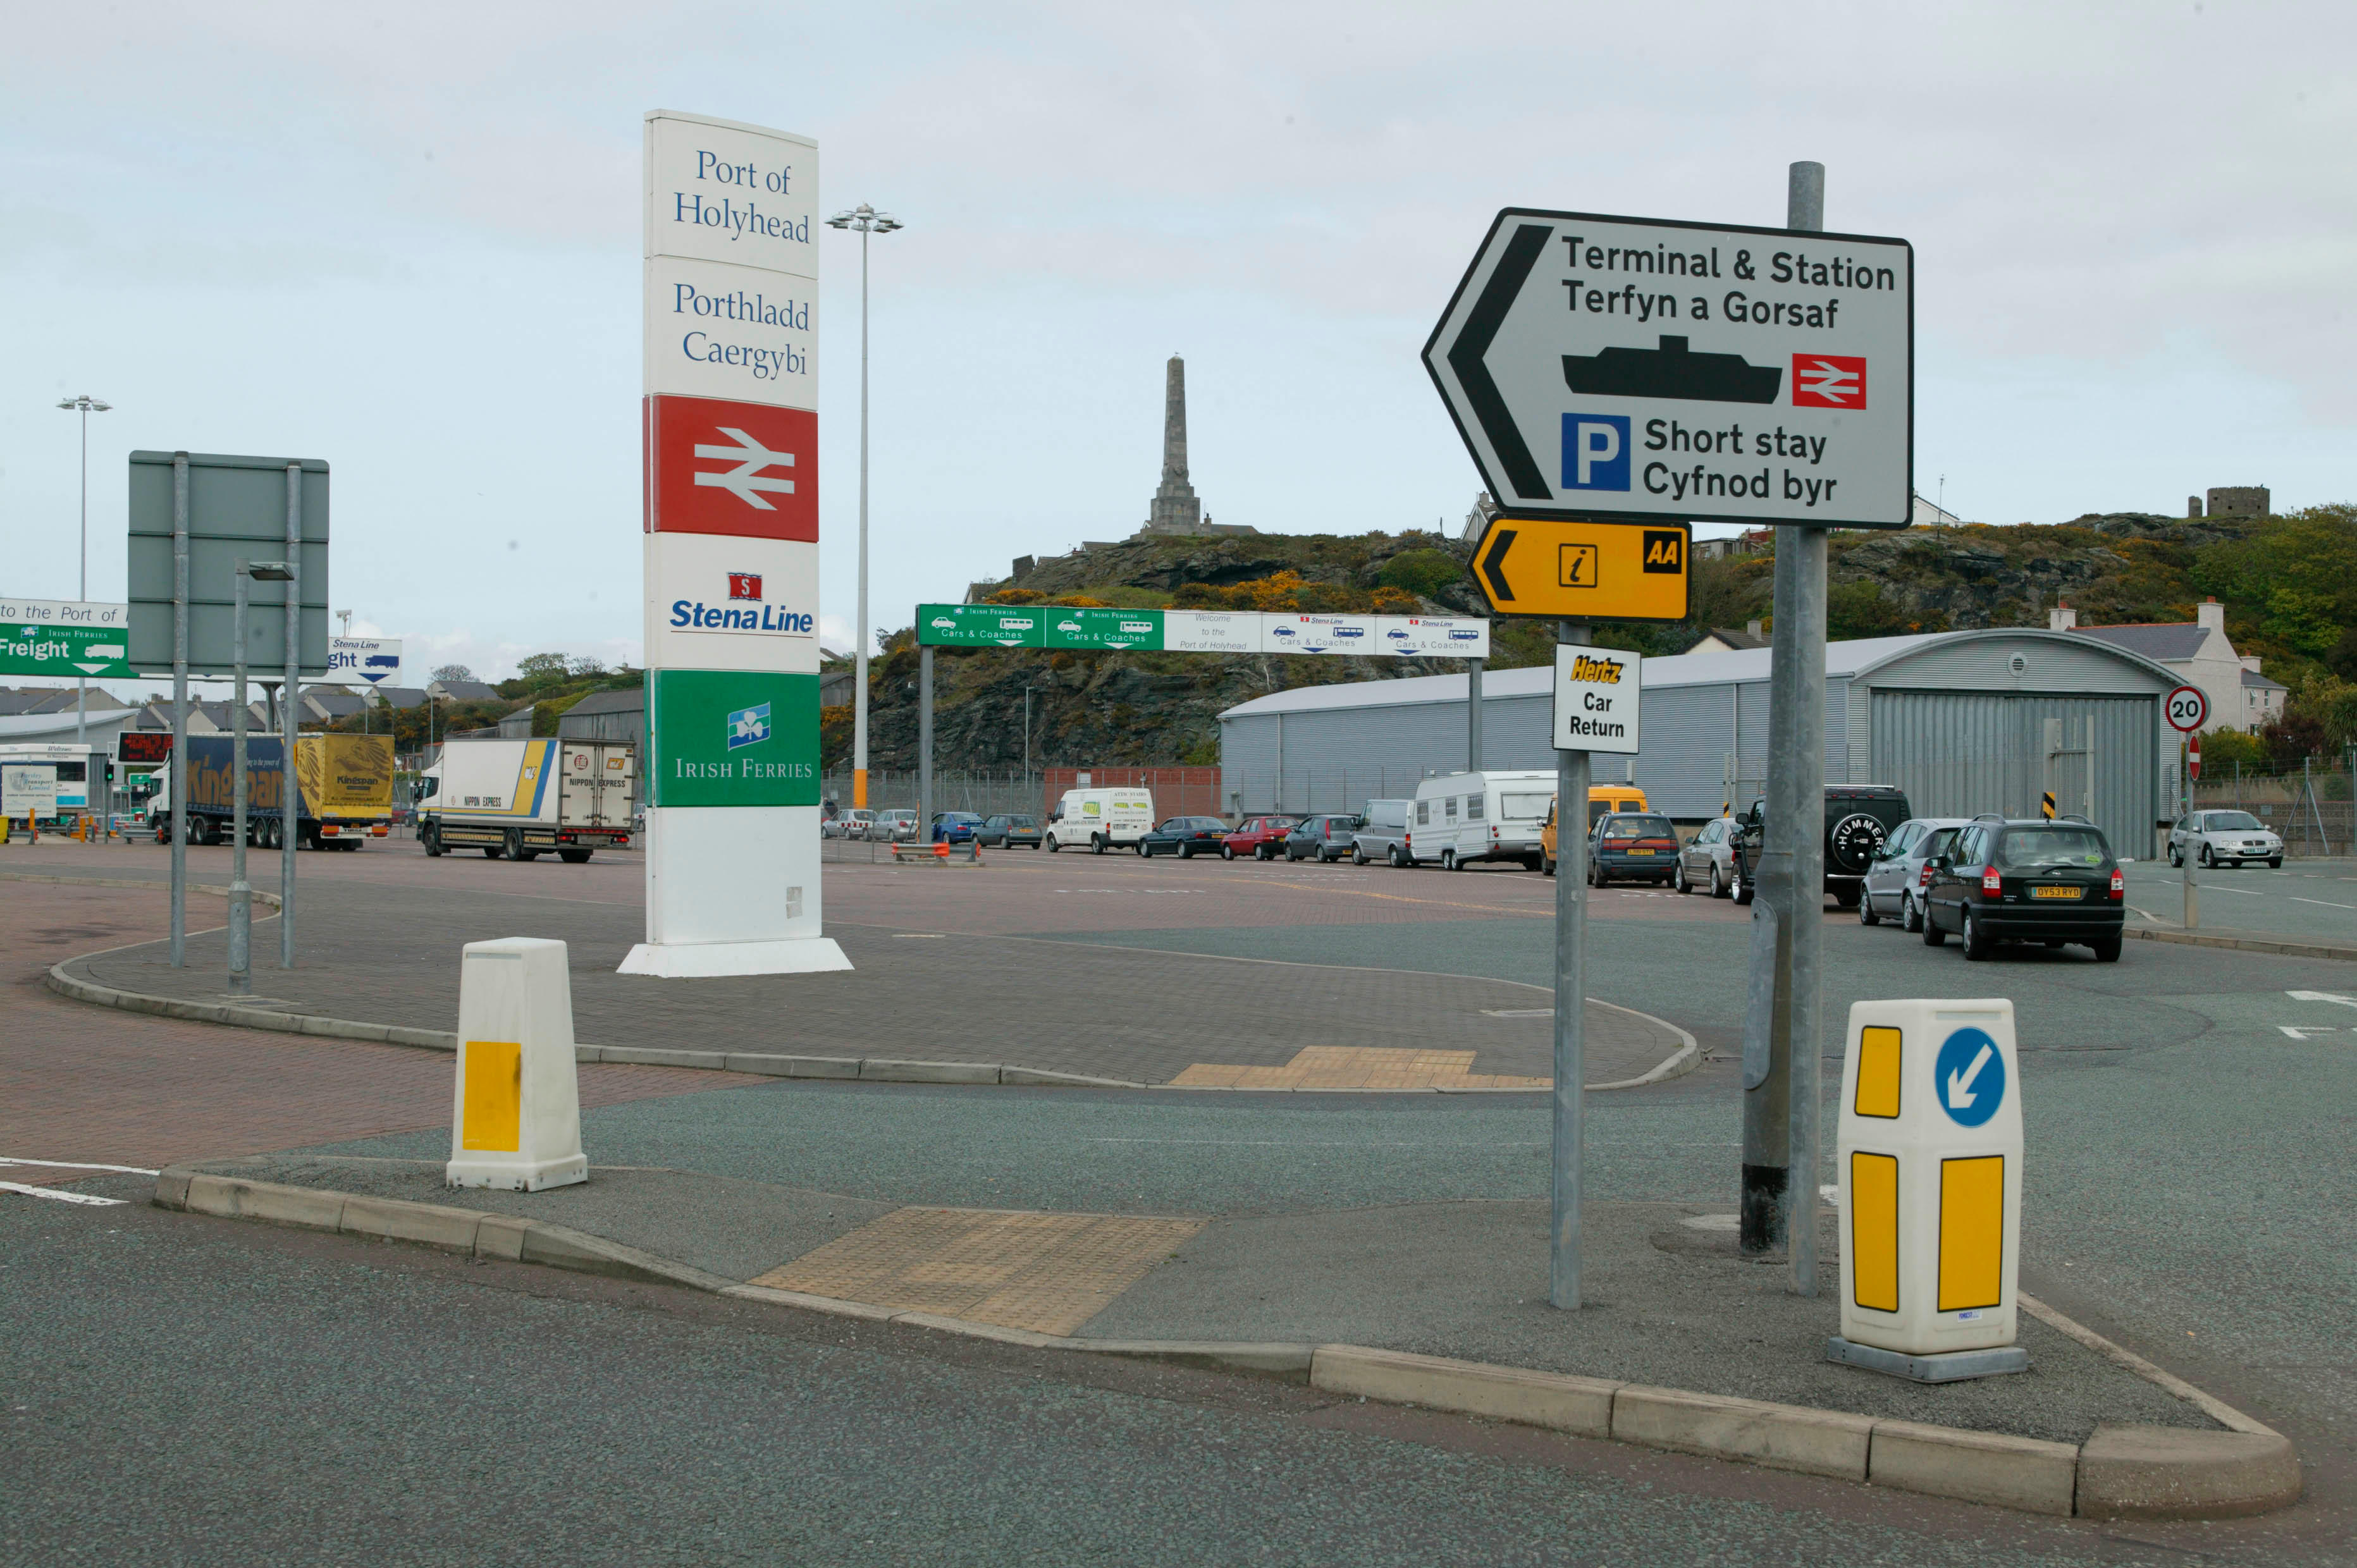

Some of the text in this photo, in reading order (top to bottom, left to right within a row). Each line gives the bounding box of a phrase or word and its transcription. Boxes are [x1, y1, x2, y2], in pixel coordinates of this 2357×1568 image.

[696, 150, 791, 195] Port of
[674, 192, 810, 244] Holyhead
[1561, 236, 1895, 291] Terminal & Station
[674, 283, 809, 331] Porthladd
[1561, 279, 1839, 329] Terfyn a Gorsaf
[683, 331, 806, 381] Caergybi
[1644, 419, 1827, 465] Short stay
[1577, 422, 1620, 484] P
[1643, 462, 1837, 507] Cyfnod byr
[1646, 541, 1677, 565] AA
[741, 578, 750, 596] S
[1, 604, 16, 617] to
[26, 605, 51, 619] the
[61, 606, 92, 621] Port
[101, 608, 118, 622] of
[670, 600, 813, 633] Stena Line
[1195, 613, 1231, 622] Welcome
[74, 630, 108, 639] FERRIES
[941, 629, 1023, 639] Cars & Coaches
[1067, 632, 1088, 640] Cars
[1104, 633, 1146, 642] Coaches
[1212, 628, 1225, 636] the
[1315, 638, 1355, 646] Coaches
[0, 639, 70, 661] Freight
[333, 639, 379, 649] Stena Line
[1210, 642, 1247, 650] Holyhead
[1570, 654, 1624, 684] Hertz
[1584, 692, 1612, 712] Car
[2172, 700, 2199, 718] 20
[1570, 716, 1624, 737] Return
[675, 758, 813, 778] IRISH FERRIES
[187, 754, 283, 807] Kingpan
[337, 776, 378, 785] Kingspan
[569, 778, 625, 788] NIPPON EXPRESS
[464, 796, 502, 807] NIPPON EXPRESS
[1838, 819, 1884, 845] HUMMER
[2038, 888, 2079, 897] OY53 RYD
